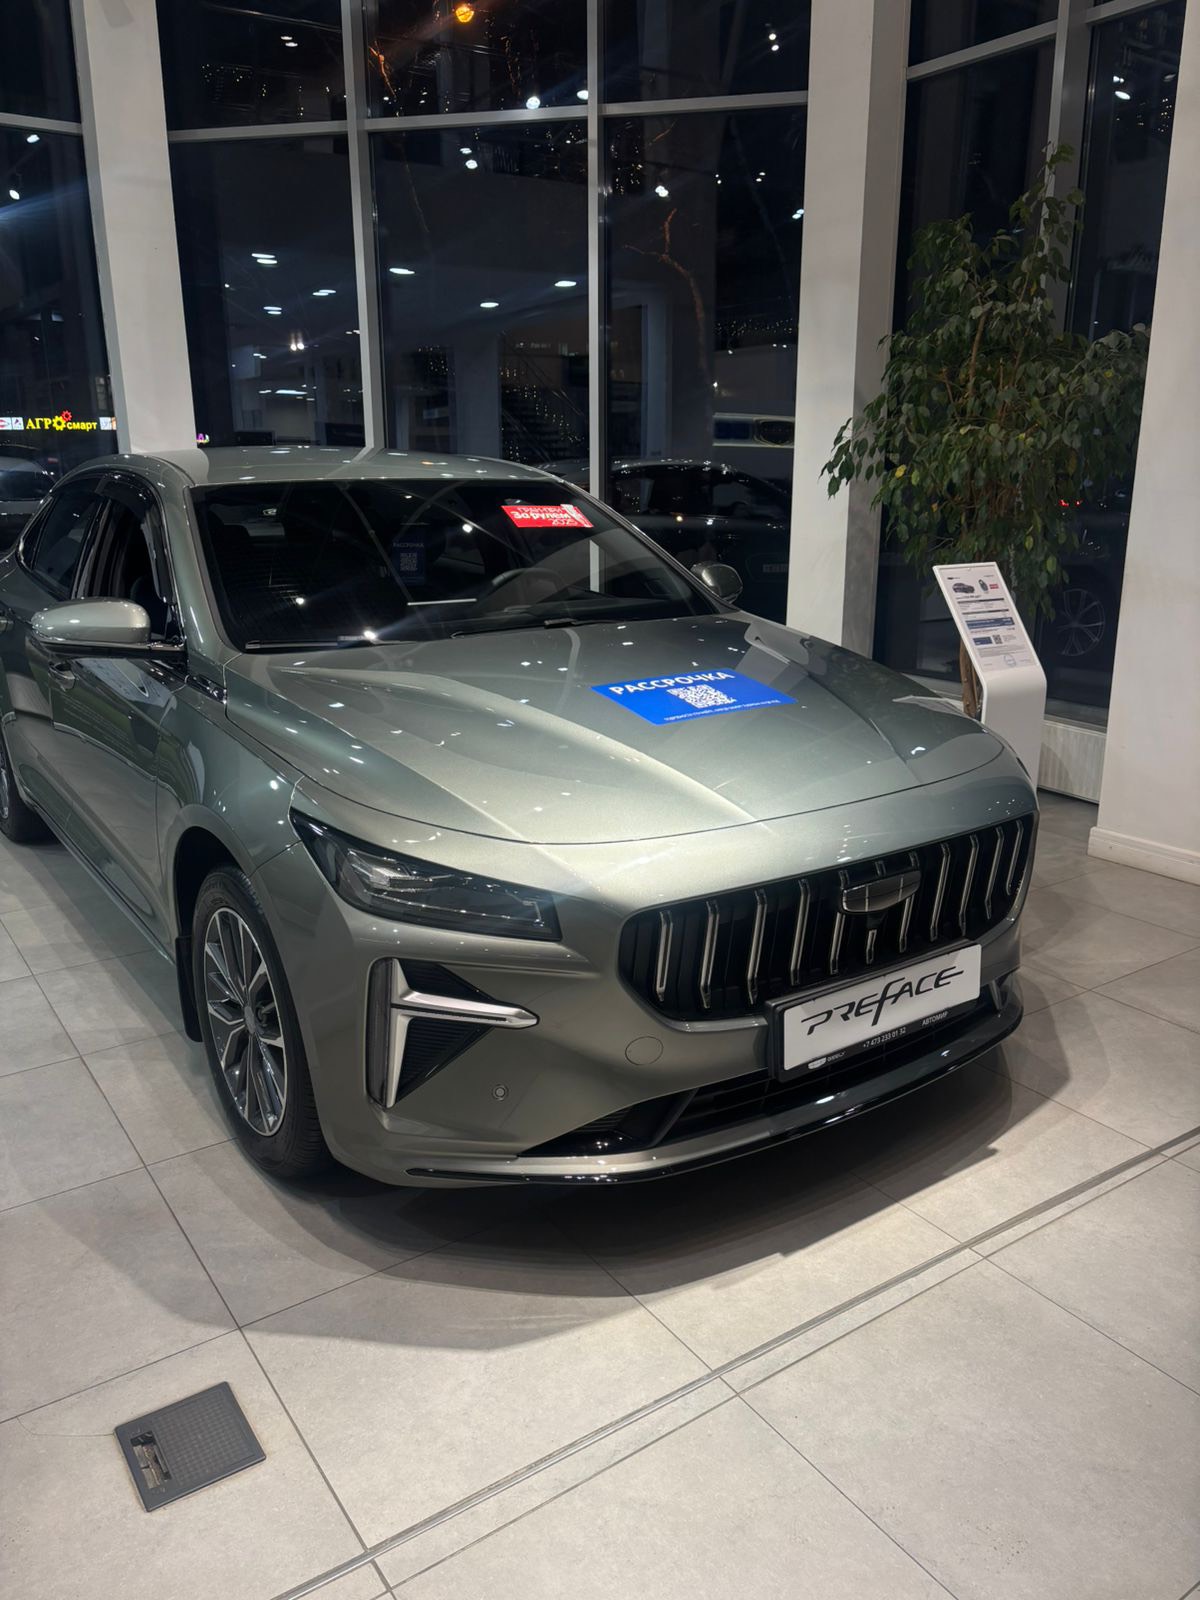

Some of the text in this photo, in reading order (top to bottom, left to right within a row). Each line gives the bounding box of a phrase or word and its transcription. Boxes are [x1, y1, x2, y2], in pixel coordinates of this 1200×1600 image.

[608, 671, 735, 696] РАССРОЧКА
[801, 966, 964, 1036] PREFACE
[922, 1011, 949, 1026] АВТОМИР
